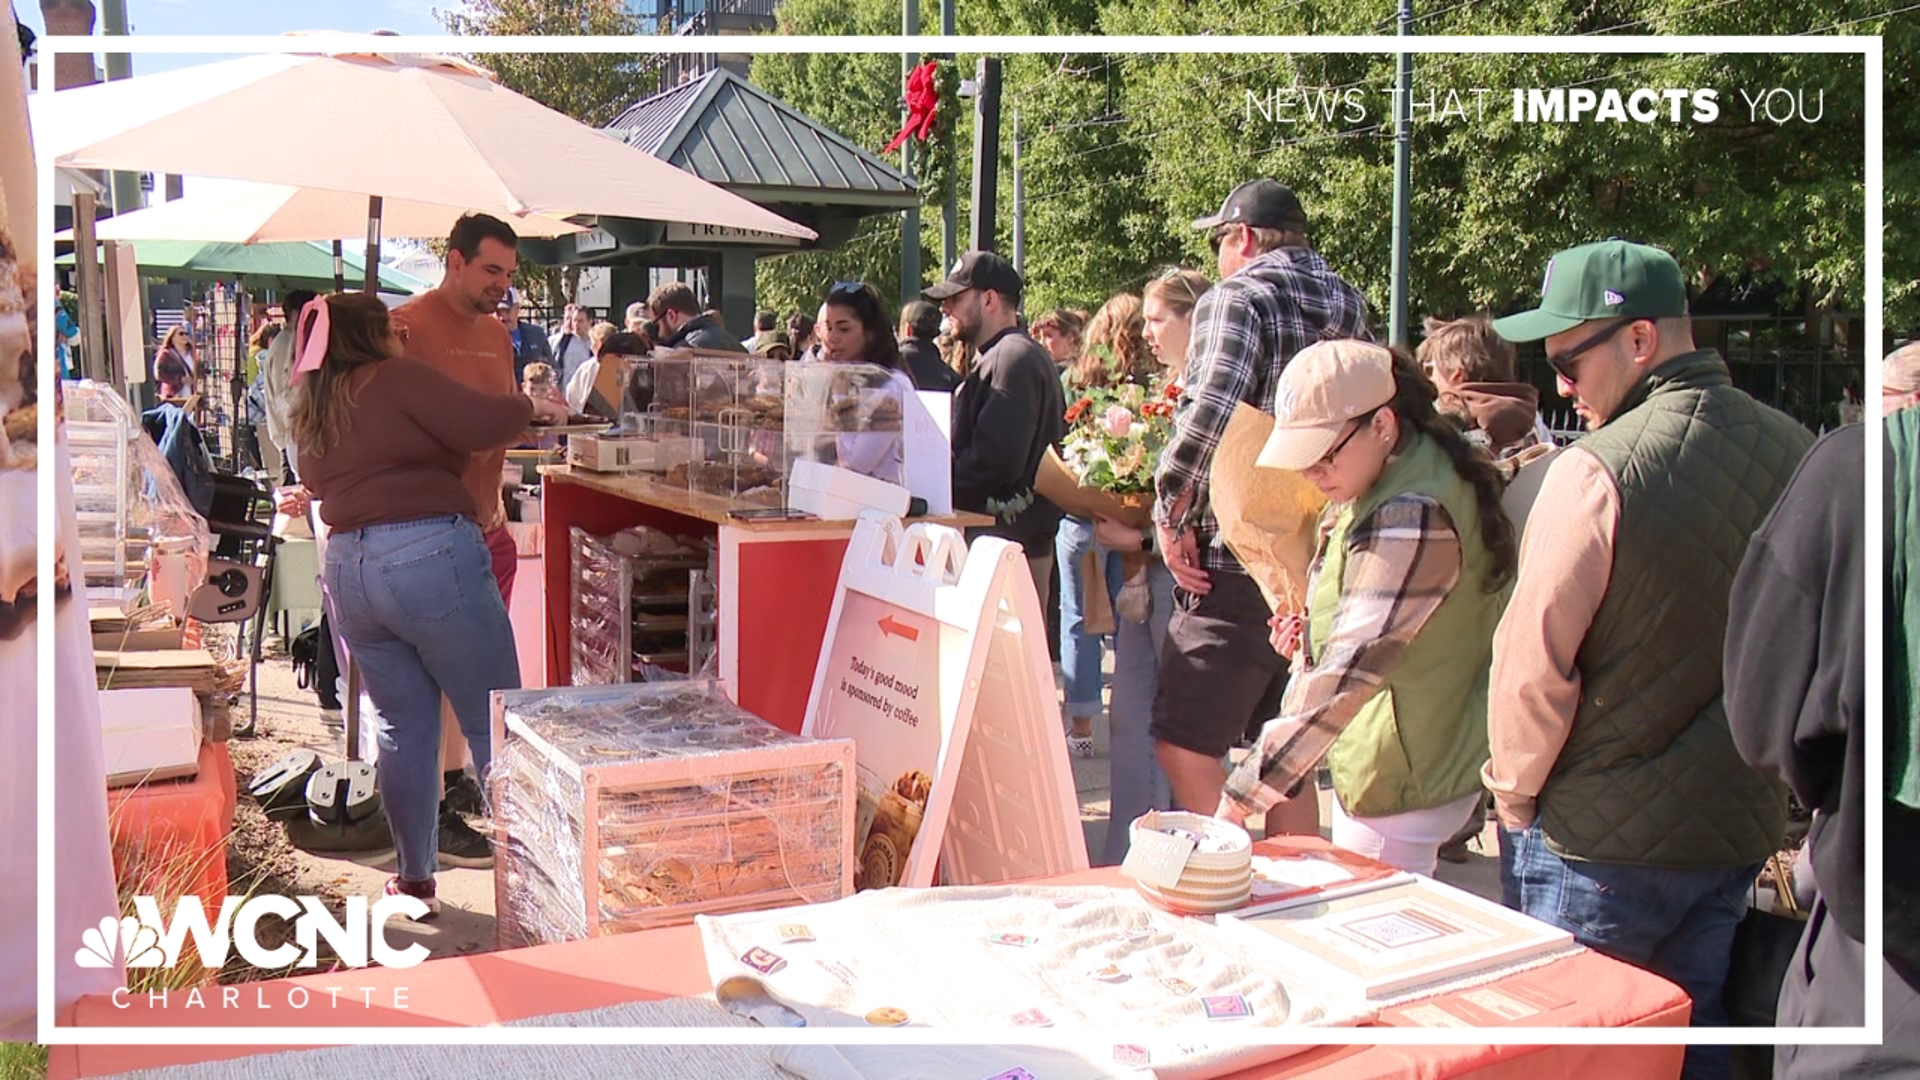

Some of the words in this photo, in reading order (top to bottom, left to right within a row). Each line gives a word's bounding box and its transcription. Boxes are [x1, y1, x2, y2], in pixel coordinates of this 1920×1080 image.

[687, 222, 784, 239] TREMO
[849, 655, 875, 680] Today's
[874, 671, 895, 686] good
[893, 684, 919, 699] mood
[840, 677, 848, 692] is
[846, 684, 884, 710] sponsored
[882, 698, 894, 718] by
[893, 707, 919, 728] coffee
